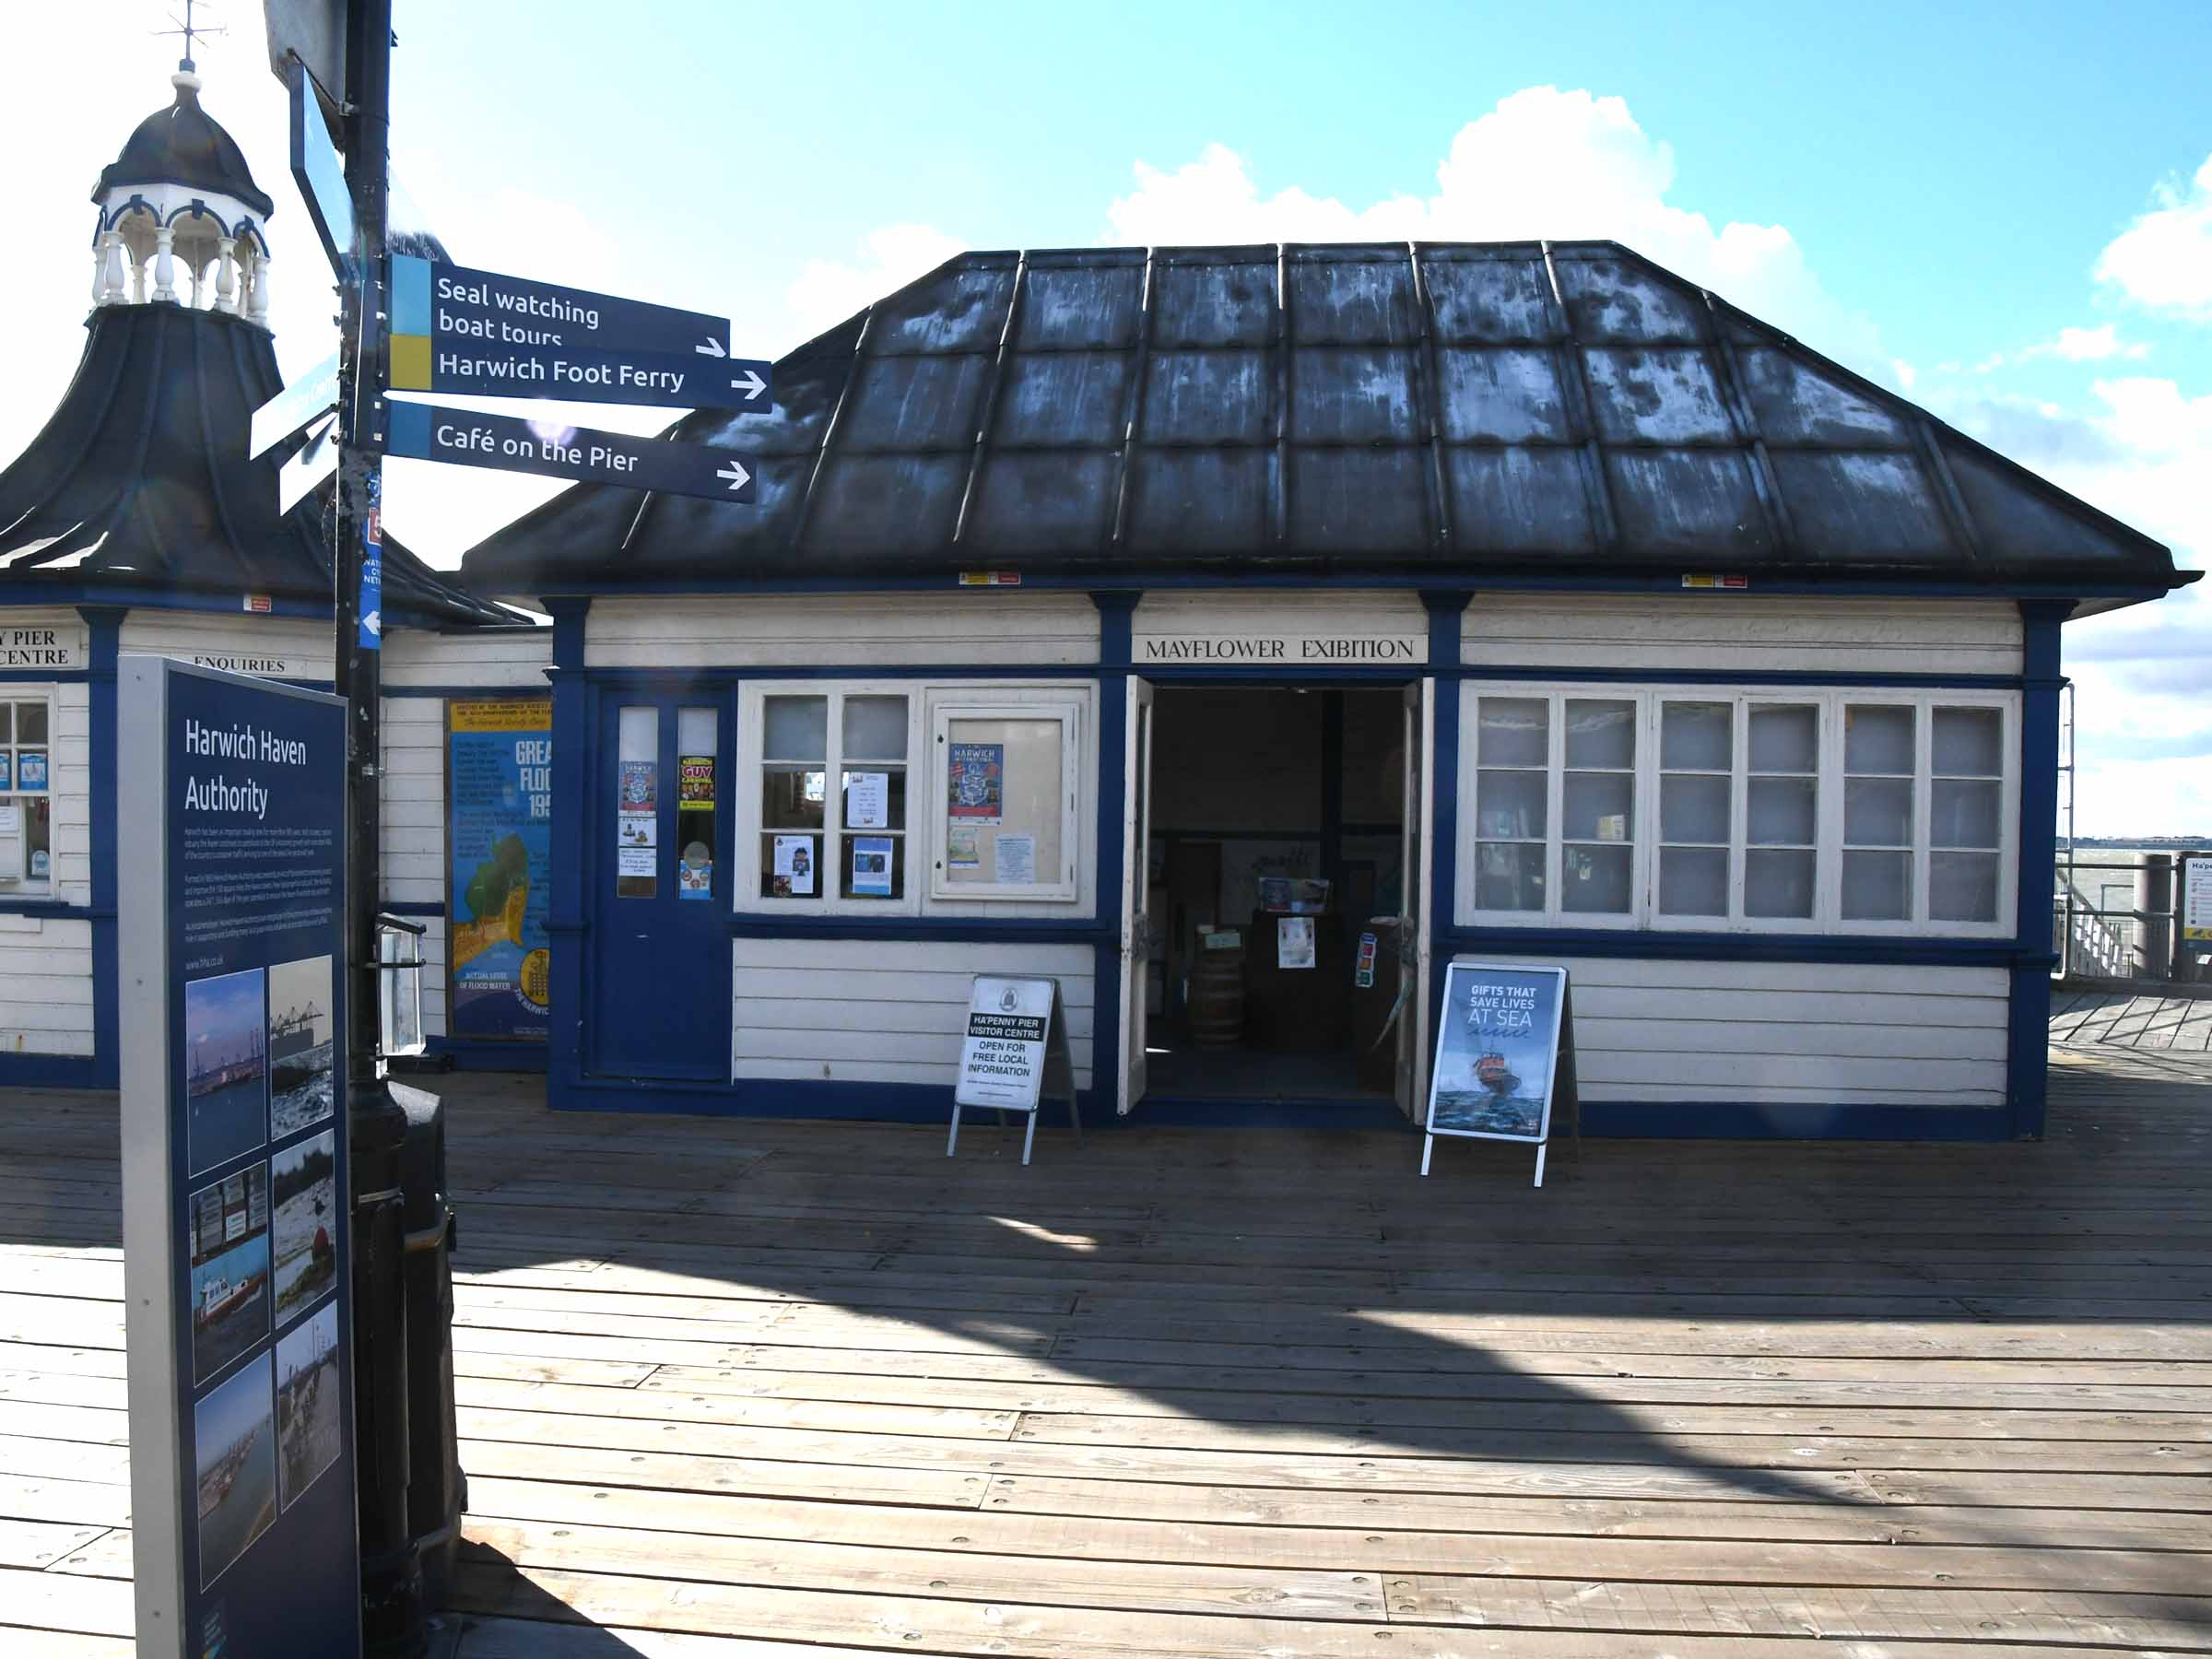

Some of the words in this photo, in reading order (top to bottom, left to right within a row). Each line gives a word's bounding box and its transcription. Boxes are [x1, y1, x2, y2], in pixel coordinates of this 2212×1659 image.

[437, 277, 488, 306] Seal
[496, 290, 599, 330] watching
[439, 309, 494, 339] boat
[501, 323, 561, 346] tours
[439, 353, 545, 381] Harwich
[553, 360, 611, 385] Foot
[619, 365, 685, 394] Ferry
[437, 425, 494, 453] Café
[502, 437, 534, 459] on
[541, 441, 582, 465] the
[590, 447, 638, 472] Pier
[14, 630, 56, 645] PIER
[1145, 639, 1285, 659] MAYFLOWER
[1301, 639, 1414, 659] EXIBITION
[194, 655, 285, 672] ENQUIRIES
[185, 719, 255, 760] Harwich
[261, 730, 306, 766] Haven
[682, 766, 713, 779] GUY
[184, 775, 268, 819] Authority
[1471, 985, 1504, 996] GIFTS
[1506, 987, 1537, 997] THAT
[1470, 996, 1499, 1007] SAVE
[1502, 998, 1535, 1009] LIVES
[973, 1016, 1017, 1026] HA'PENNY
[1018, 1018, 1039, 1028] PIER
[1467, 1008, 1491, 1024] AT
[1496, 1010, 1533, 1027] SEA
[970, 1026, 1003, 1037] VISITOR
[1005, 1029, 1041, 1039] CENTRE
[979, 1041, 1005, 1051] OPEN
[1006, 1042, 1026, 1053] FOR
[973, 1053, 996, 1062] FREE
[998, 1054, 1029, 1065] LOCAL
[968, 1064, 1030, 1077] INFORMATION
